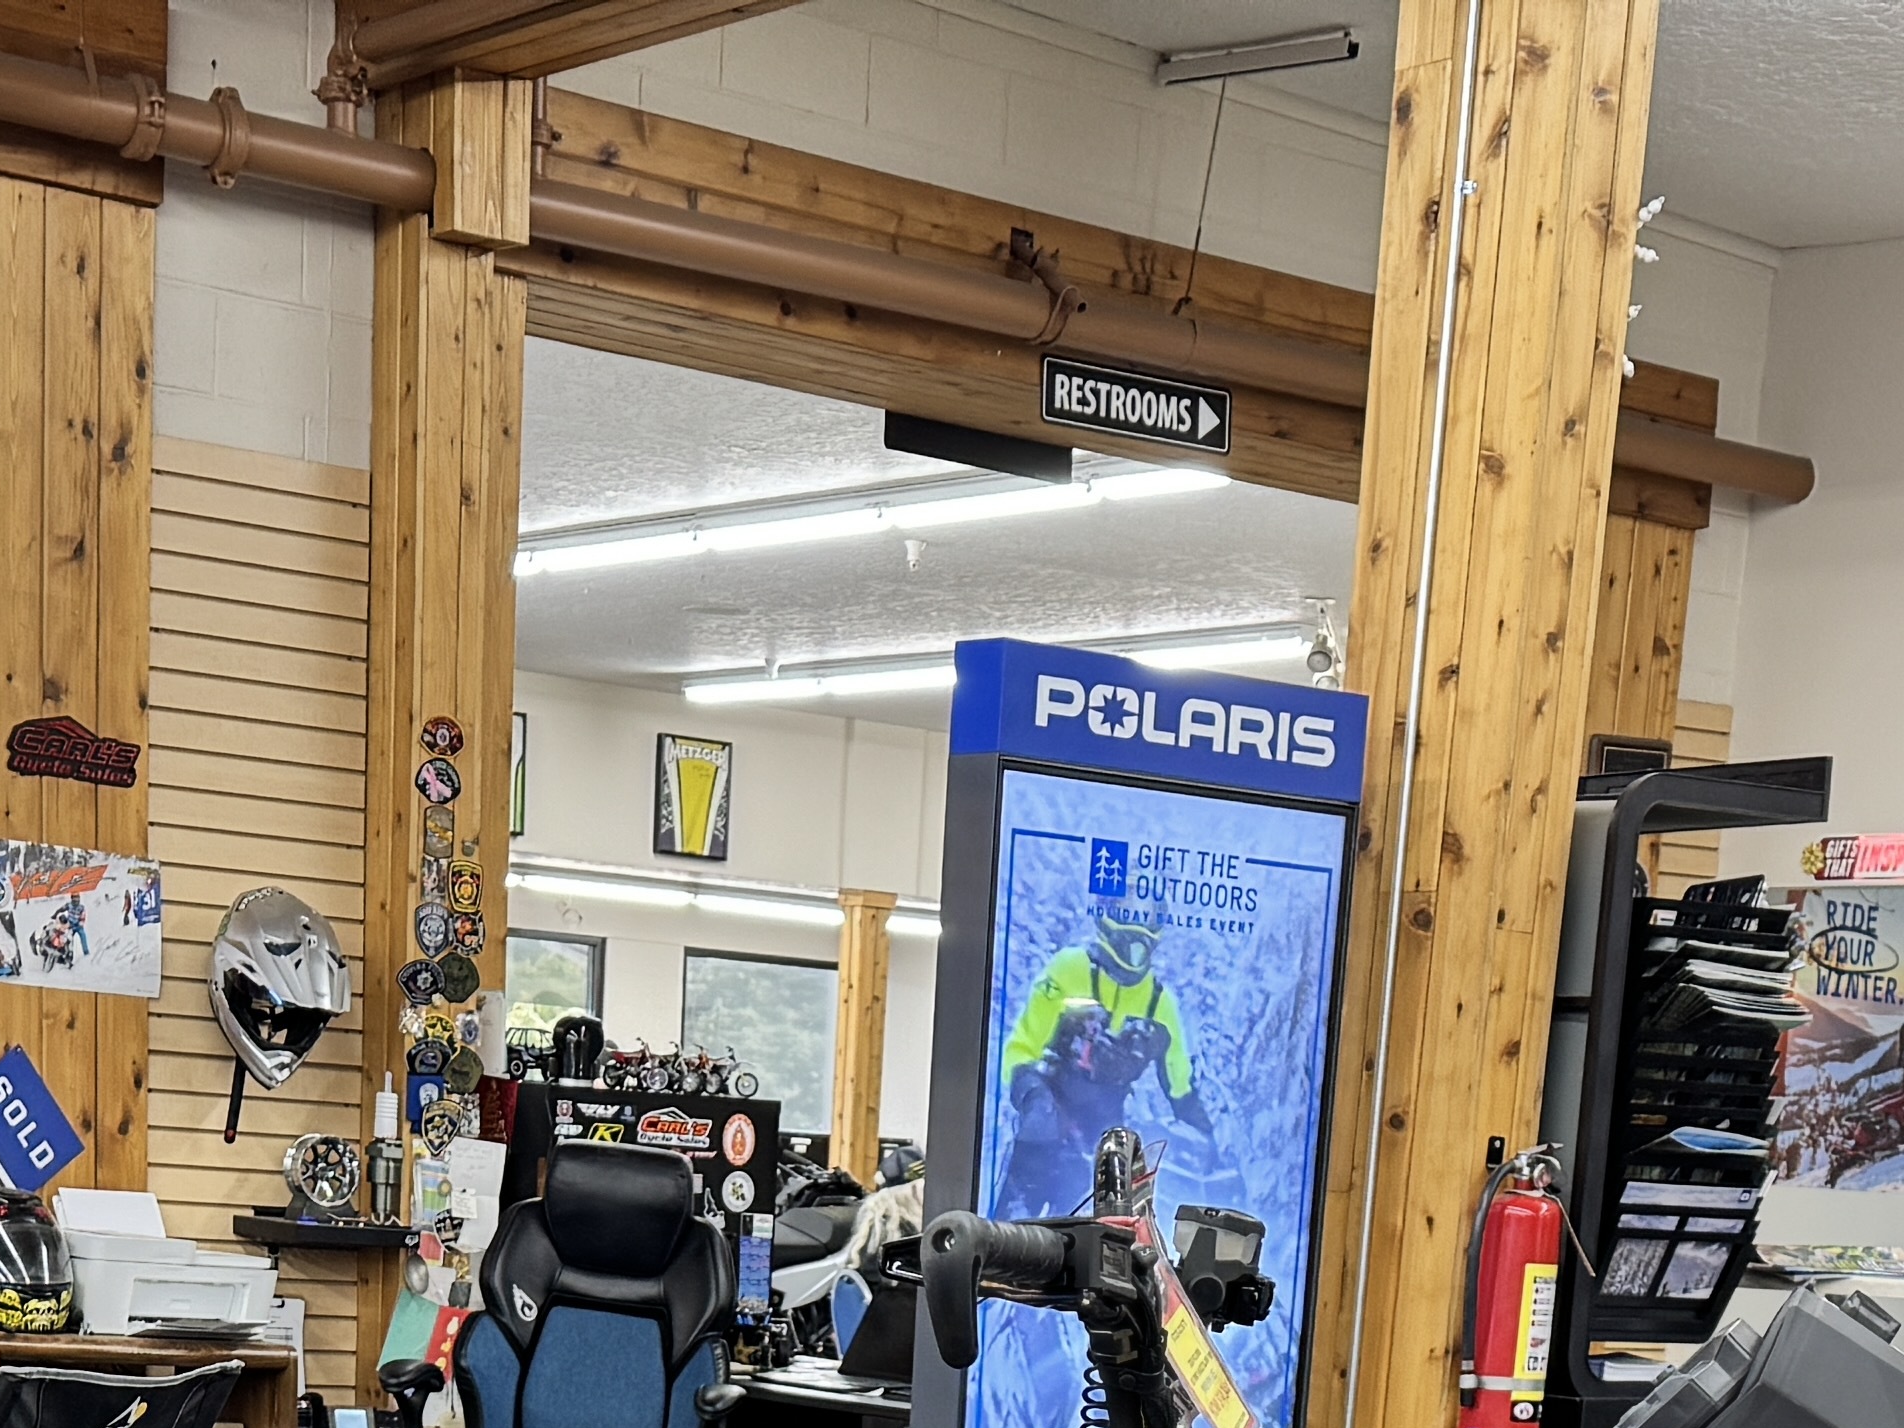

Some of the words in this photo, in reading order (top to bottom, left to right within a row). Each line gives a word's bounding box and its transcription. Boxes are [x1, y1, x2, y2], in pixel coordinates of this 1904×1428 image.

[1054, 374, 1191, 432] RESTROOMS
[1035, 675, 1336, 768] POLARIS
[13, 727, 139, 768] CARL'S
[1138, 844, 1190, 873] GIFT
[1197, 851, 1239, 879] THE
[1826, 840, 1859, 858] GIFTS
[1824, 859, 1854, 878] THAT
[1137, 875, 1258, 912] OUTDOORS
[1157, 913, 1202, 928] SALES
[1210, 918, 1254, 934] EVENT
[1827, 900, 1879, 933] RIDE
[1824, 934, 1876, 967] YOUR
[1816, 967, 1904, 1005] WINTER.
[641, 1115, 711, 1137] CARL'S
